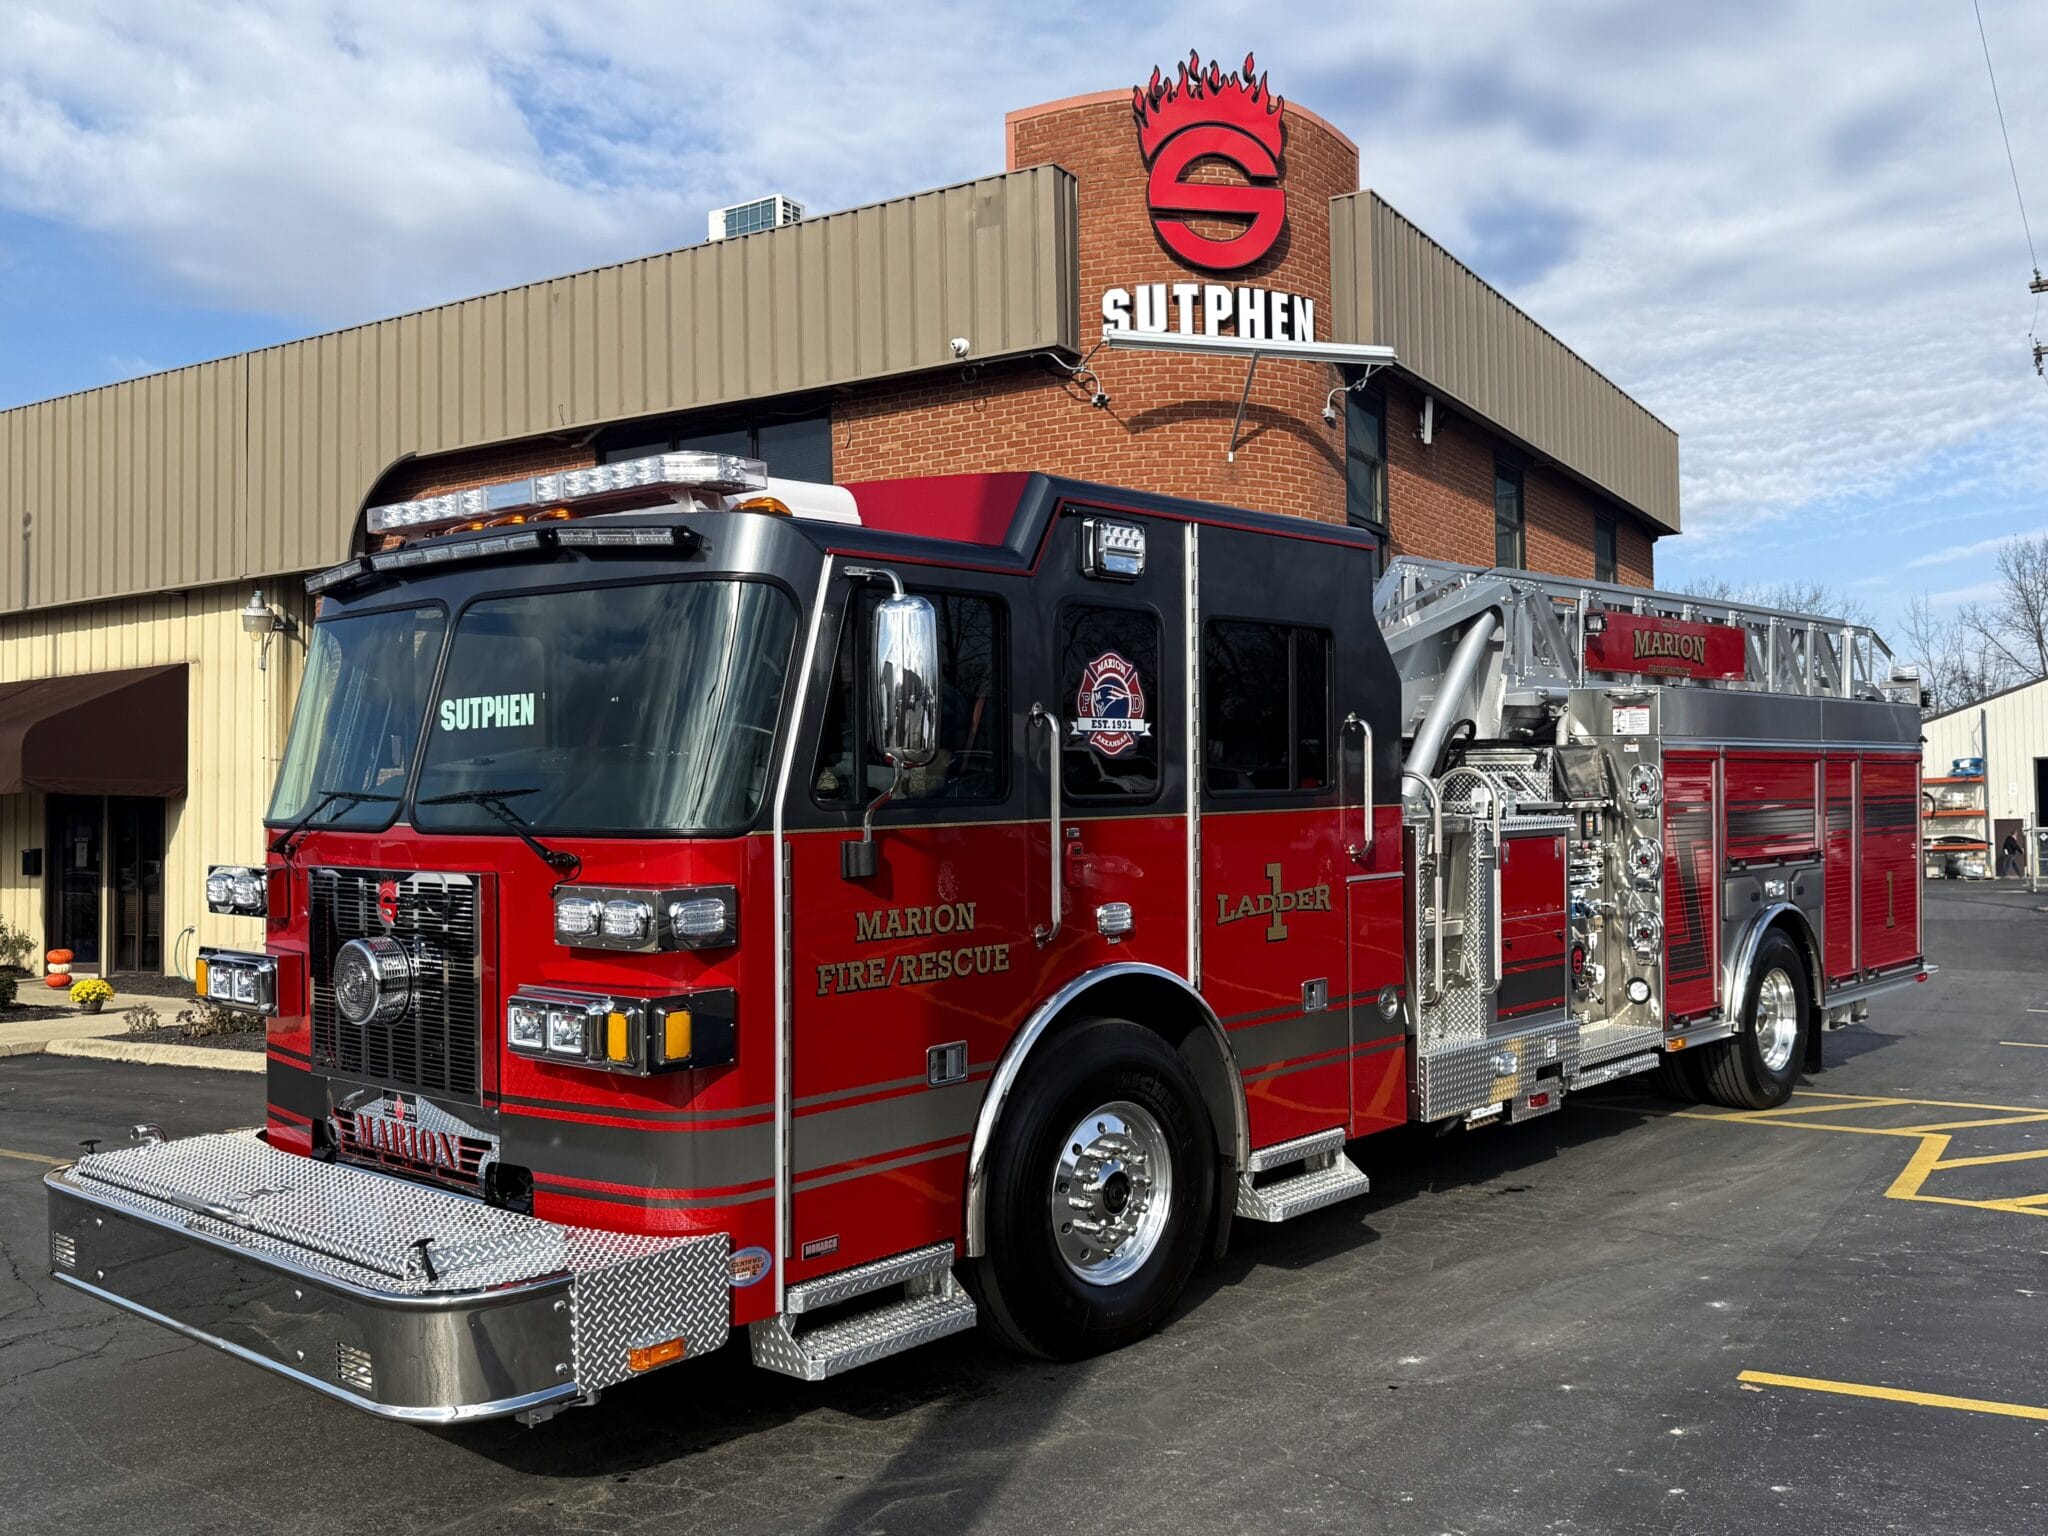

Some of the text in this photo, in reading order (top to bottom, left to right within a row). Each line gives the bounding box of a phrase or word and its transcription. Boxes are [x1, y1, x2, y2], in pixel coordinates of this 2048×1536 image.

[1102, 283, 1314, 342] SUTPHEN
[1633, 629, 1706, 664] MARION
[1097, 658, 1126, 675] MARION
[440, 693, 535, 731] SUTPHEN
[1091, 719, 1132, 729] EST. 1931
[1096, 734, 1128, 747] ARKANSAS
[1217, 884, 1333, 925] LADDER
[1886, 871, 1895, 928] 1
[855, 902, 977, 942] MARION
[816, 944, 1010, 996] FIRE/RESCUE
[358, 1114, 456, 1169] MARION
[731, 1257, 763, 1268] CERTIFIED
